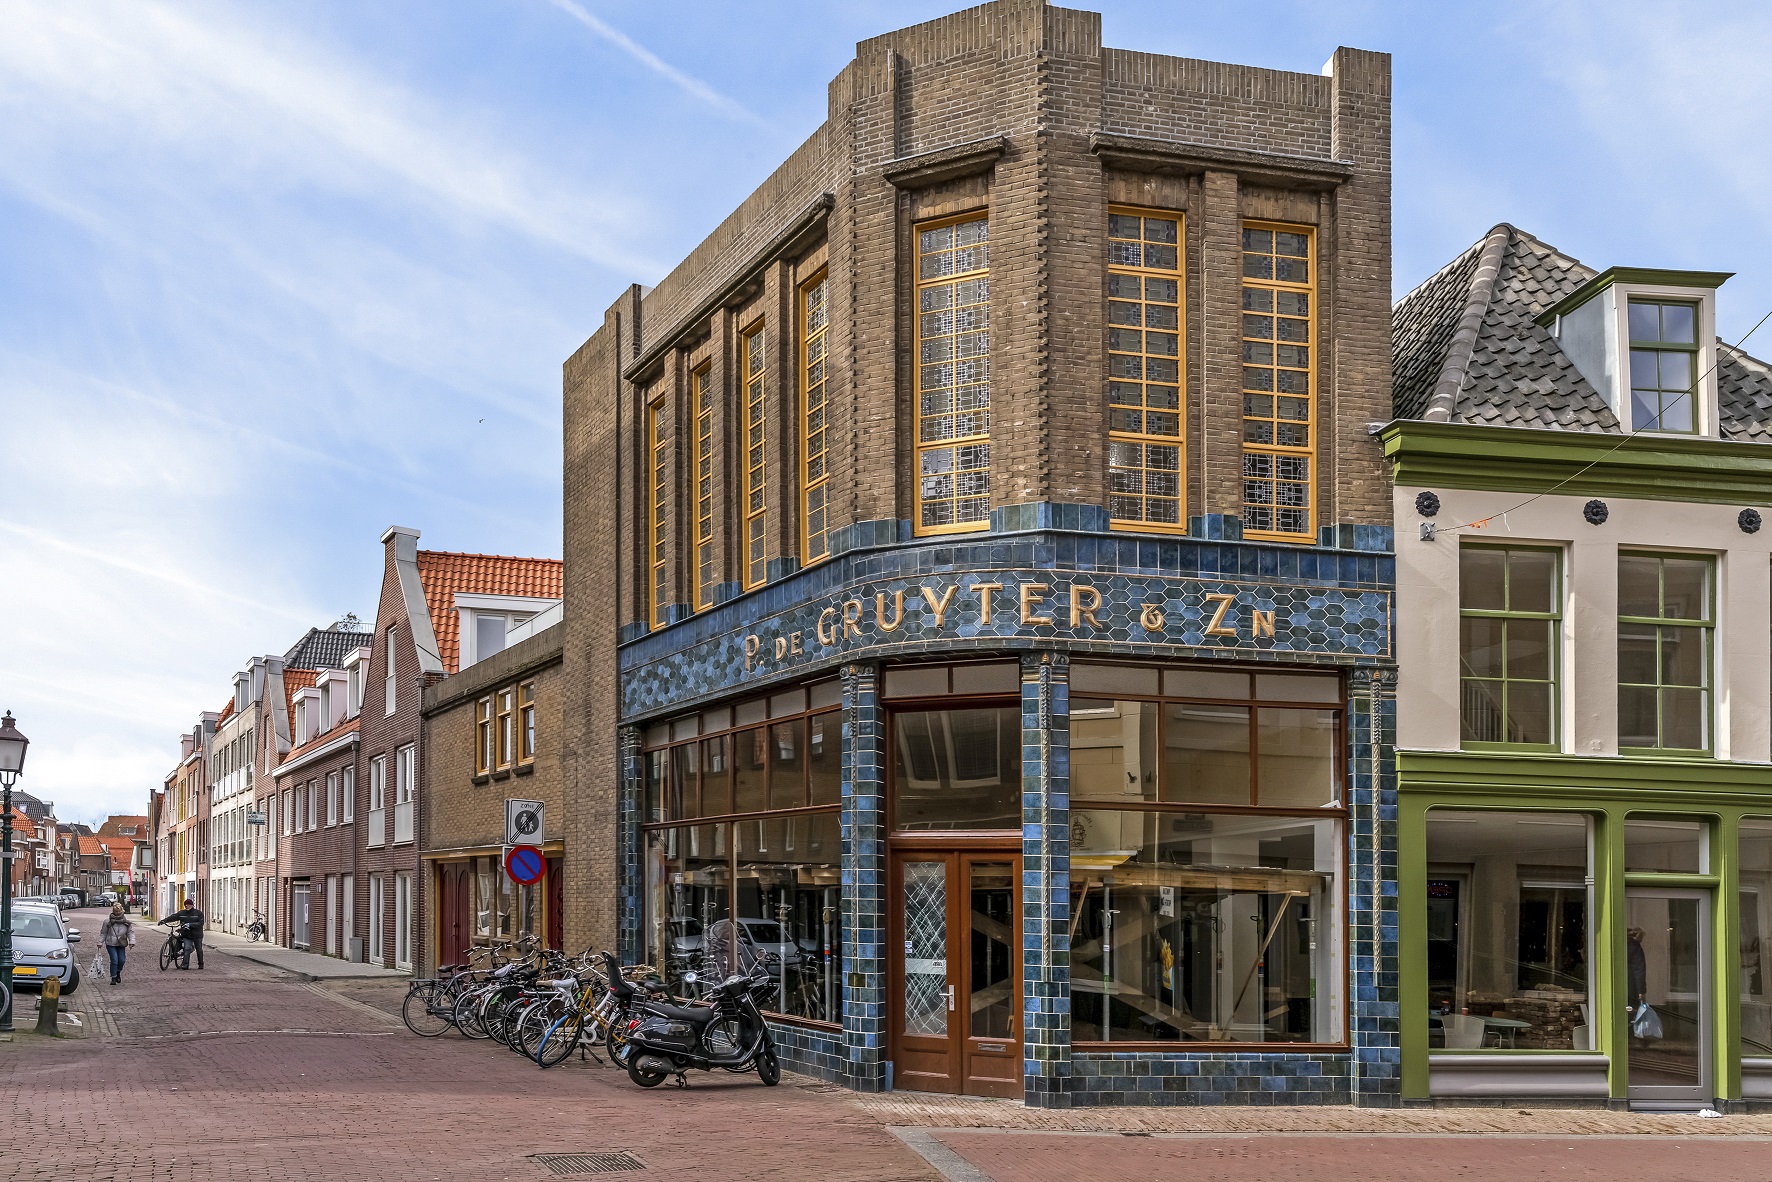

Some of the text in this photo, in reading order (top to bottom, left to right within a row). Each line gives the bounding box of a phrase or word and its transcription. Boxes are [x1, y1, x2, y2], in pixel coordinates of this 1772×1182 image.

[745, 634, 765, 671] P.
[775, 631, 803, 661] DE
[817, 582, 1104, 647] GRUYTER
